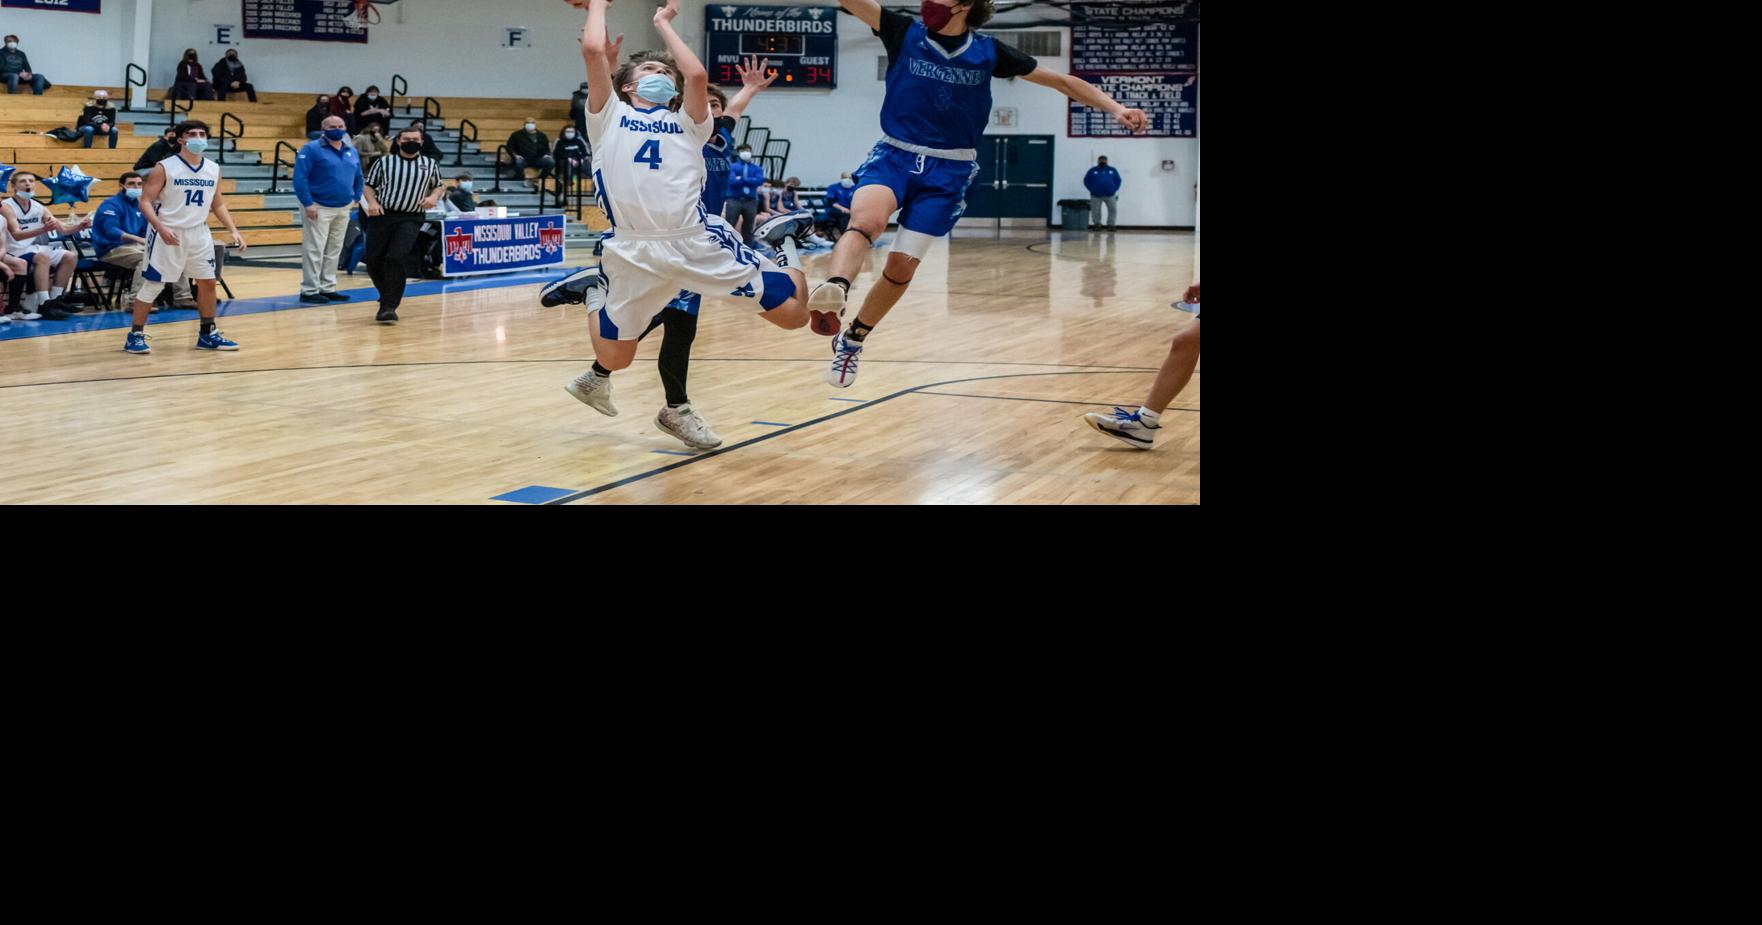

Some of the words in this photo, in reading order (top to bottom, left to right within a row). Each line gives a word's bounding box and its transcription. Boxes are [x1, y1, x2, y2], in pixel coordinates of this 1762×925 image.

[712, 18, 833, 33] THUNDERBIRDS
[217, 27, 230, 44] E
[509, 31, 522, 46] F
[717, 55, 740, 63] MVU
[799, 56, 830, 65] GUEST
[807, 67, 831, 83] 34
[1101, 76, 1165, 84] VERMONT
[1119, 83, 1183, 91] CHAMPIONS
[1160, 91, 1182, 99] FIELD
[634, 139, 663, 170] 4
[184, 189, 204, 206] 14
[473, 223, 512, 242] MISSISQUOI
[514, 221, 539, 240] VALLEY
[472, 243, 541, 265] THUNDERBIRDS
